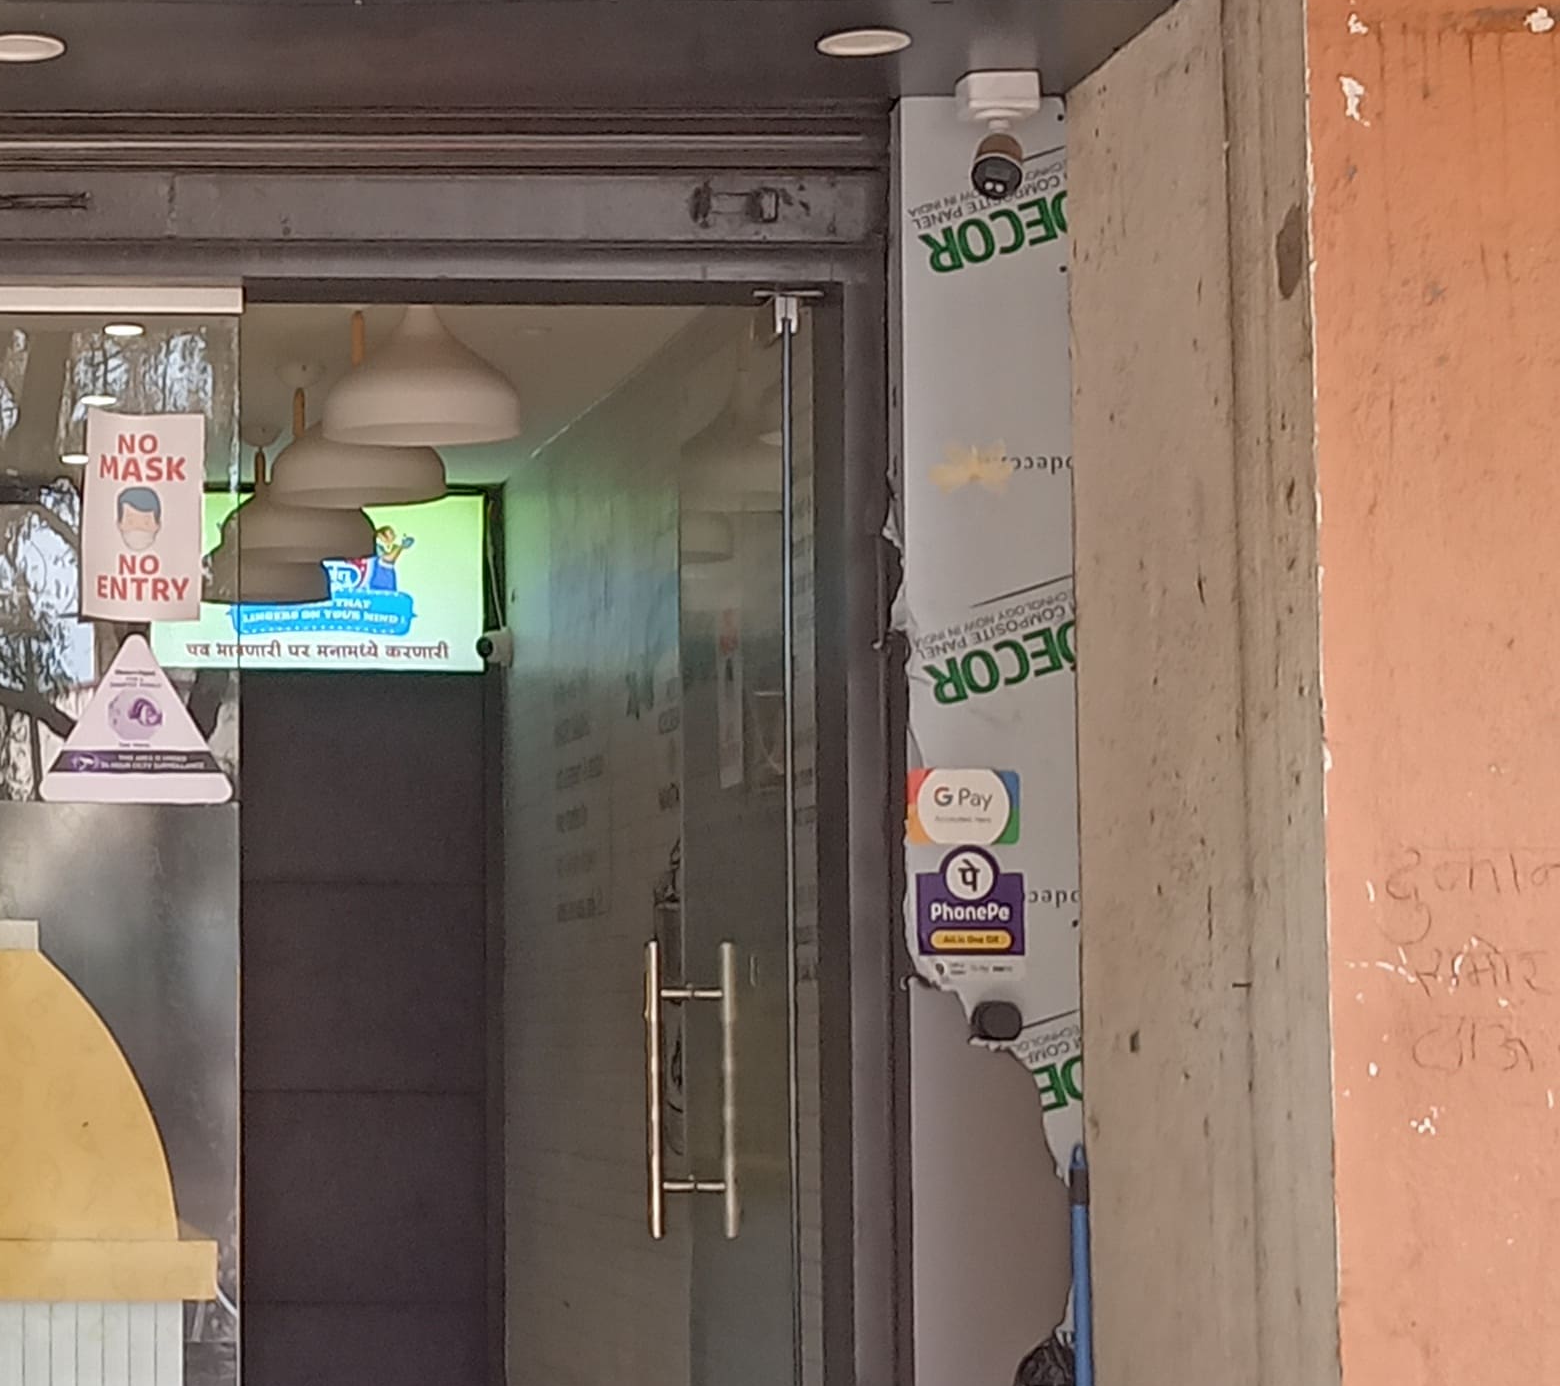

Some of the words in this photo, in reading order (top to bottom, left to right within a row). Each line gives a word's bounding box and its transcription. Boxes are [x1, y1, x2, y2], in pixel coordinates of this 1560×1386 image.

[118, 433, 158, 455] NO
[99, 454, 187, 483] MASK
[118, 553, 161, 576] NO
[96, 574, 190, 602] ENTRY
[957, 787, 993, 812] Pay
[930, 901, 1011, 922] PhonePe
